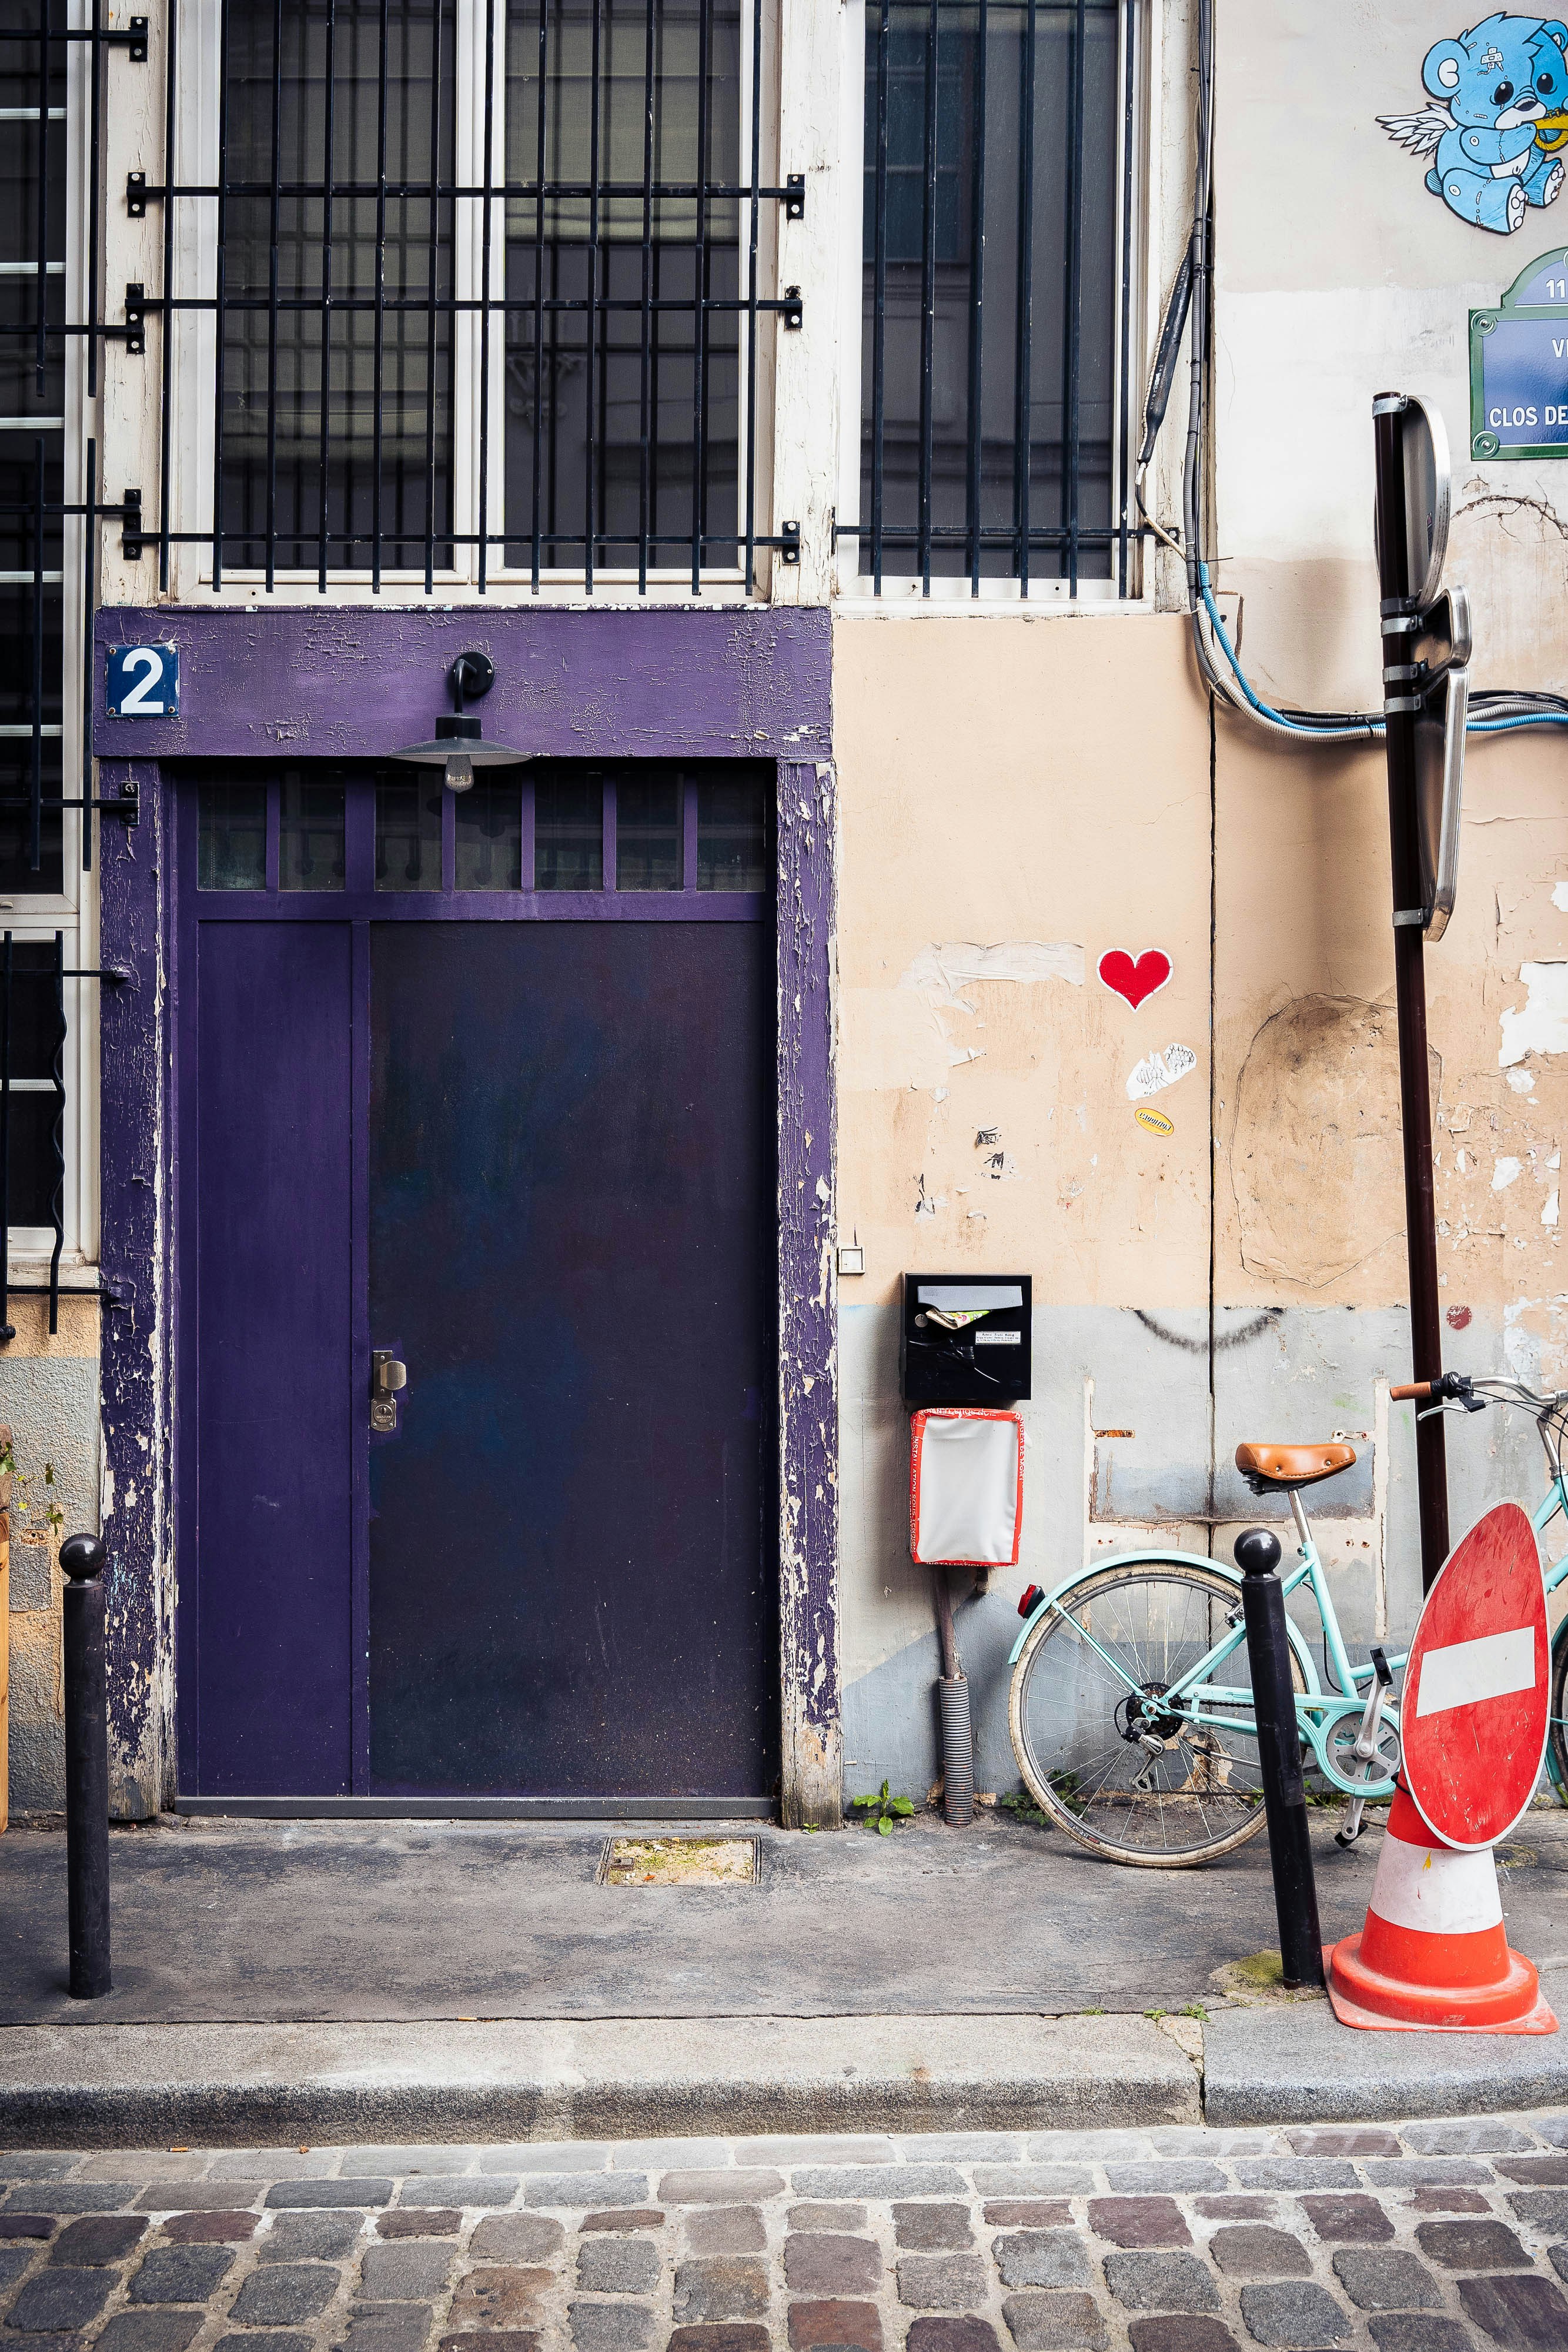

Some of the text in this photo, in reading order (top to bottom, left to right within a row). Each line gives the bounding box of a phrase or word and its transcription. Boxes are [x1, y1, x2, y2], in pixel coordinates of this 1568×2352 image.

[1489, 405, 1568, 427] CLOS DE
[121, 647, 164, 714] 2
